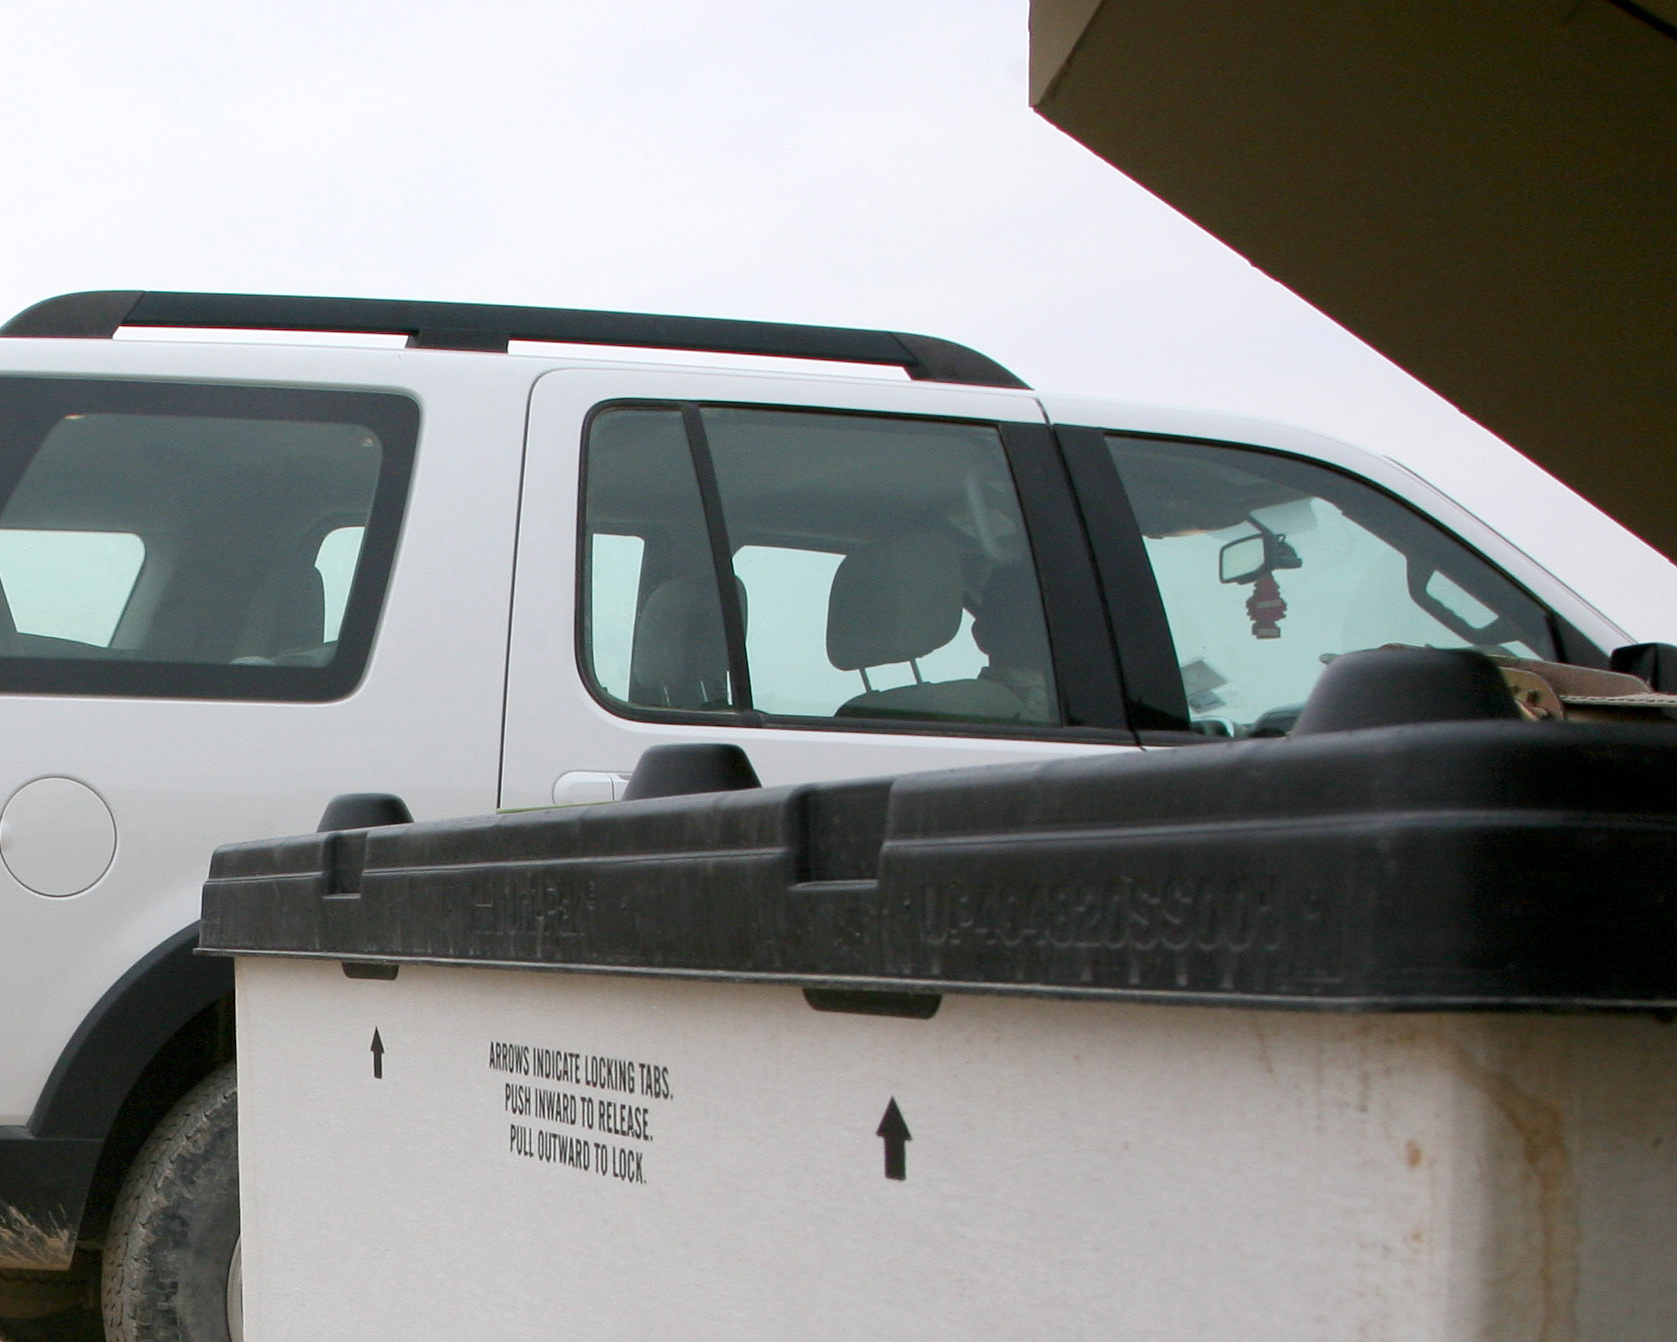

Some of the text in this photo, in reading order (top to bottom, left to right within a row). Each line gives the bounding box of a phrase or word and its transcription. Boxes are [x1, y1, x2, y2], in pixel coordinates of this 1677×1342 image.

[488, 1040, 674, 1100] ARROWS INDICATE LOCKING TABS.
[504, 1083, 653, 1141] PUSH INWARD TO RELEASE.
[509, 1124, 647, 1184] PULL OUTWARD TO LOCK.
